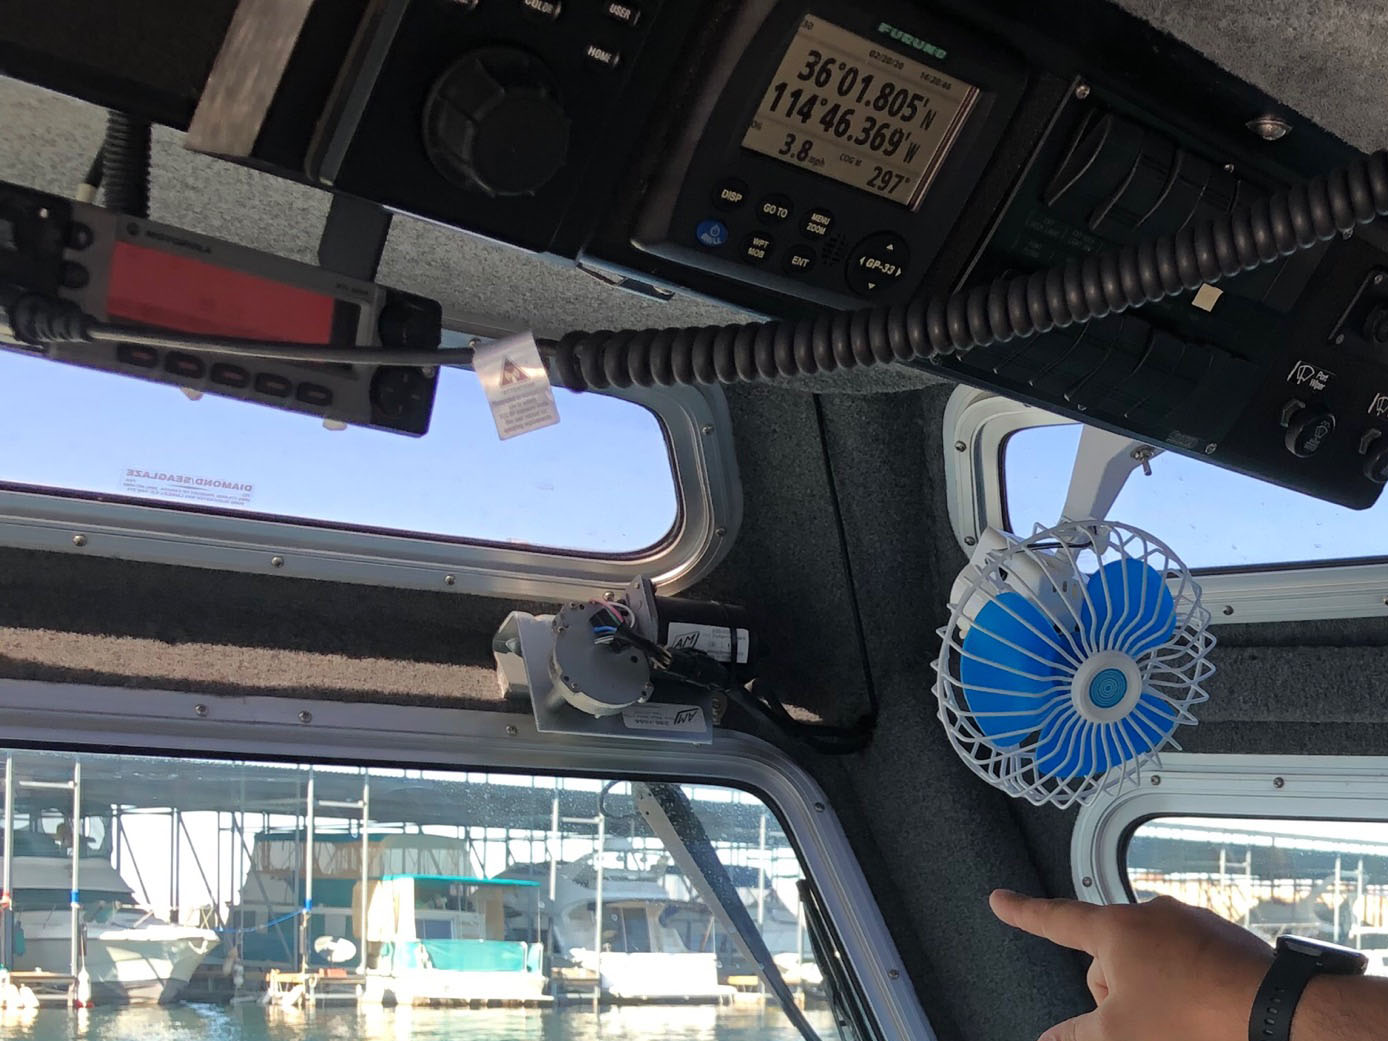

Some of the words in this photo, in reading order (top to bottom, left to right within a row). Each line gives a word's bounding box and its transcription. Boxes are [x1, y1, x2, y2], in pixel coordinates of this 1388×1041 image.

[609, 3, 631, 20] USER
[877, 22, 948, 59] FURUNO
[587, 45, 612, 63] HOME
[720, 188, 743, 203] DISP
[763, 202, 777, 216] GO
[776, 206, 788, 219] TO
[811, 212, 831, 226] MENU
[806, 222, 827, 236] ZOOM
[752, 237, 769, 248] WPT
[748, 247, 765, 259] MOB
[791, 255, 810, 268] ENT
[865, 258, 896, 275] GP-33
